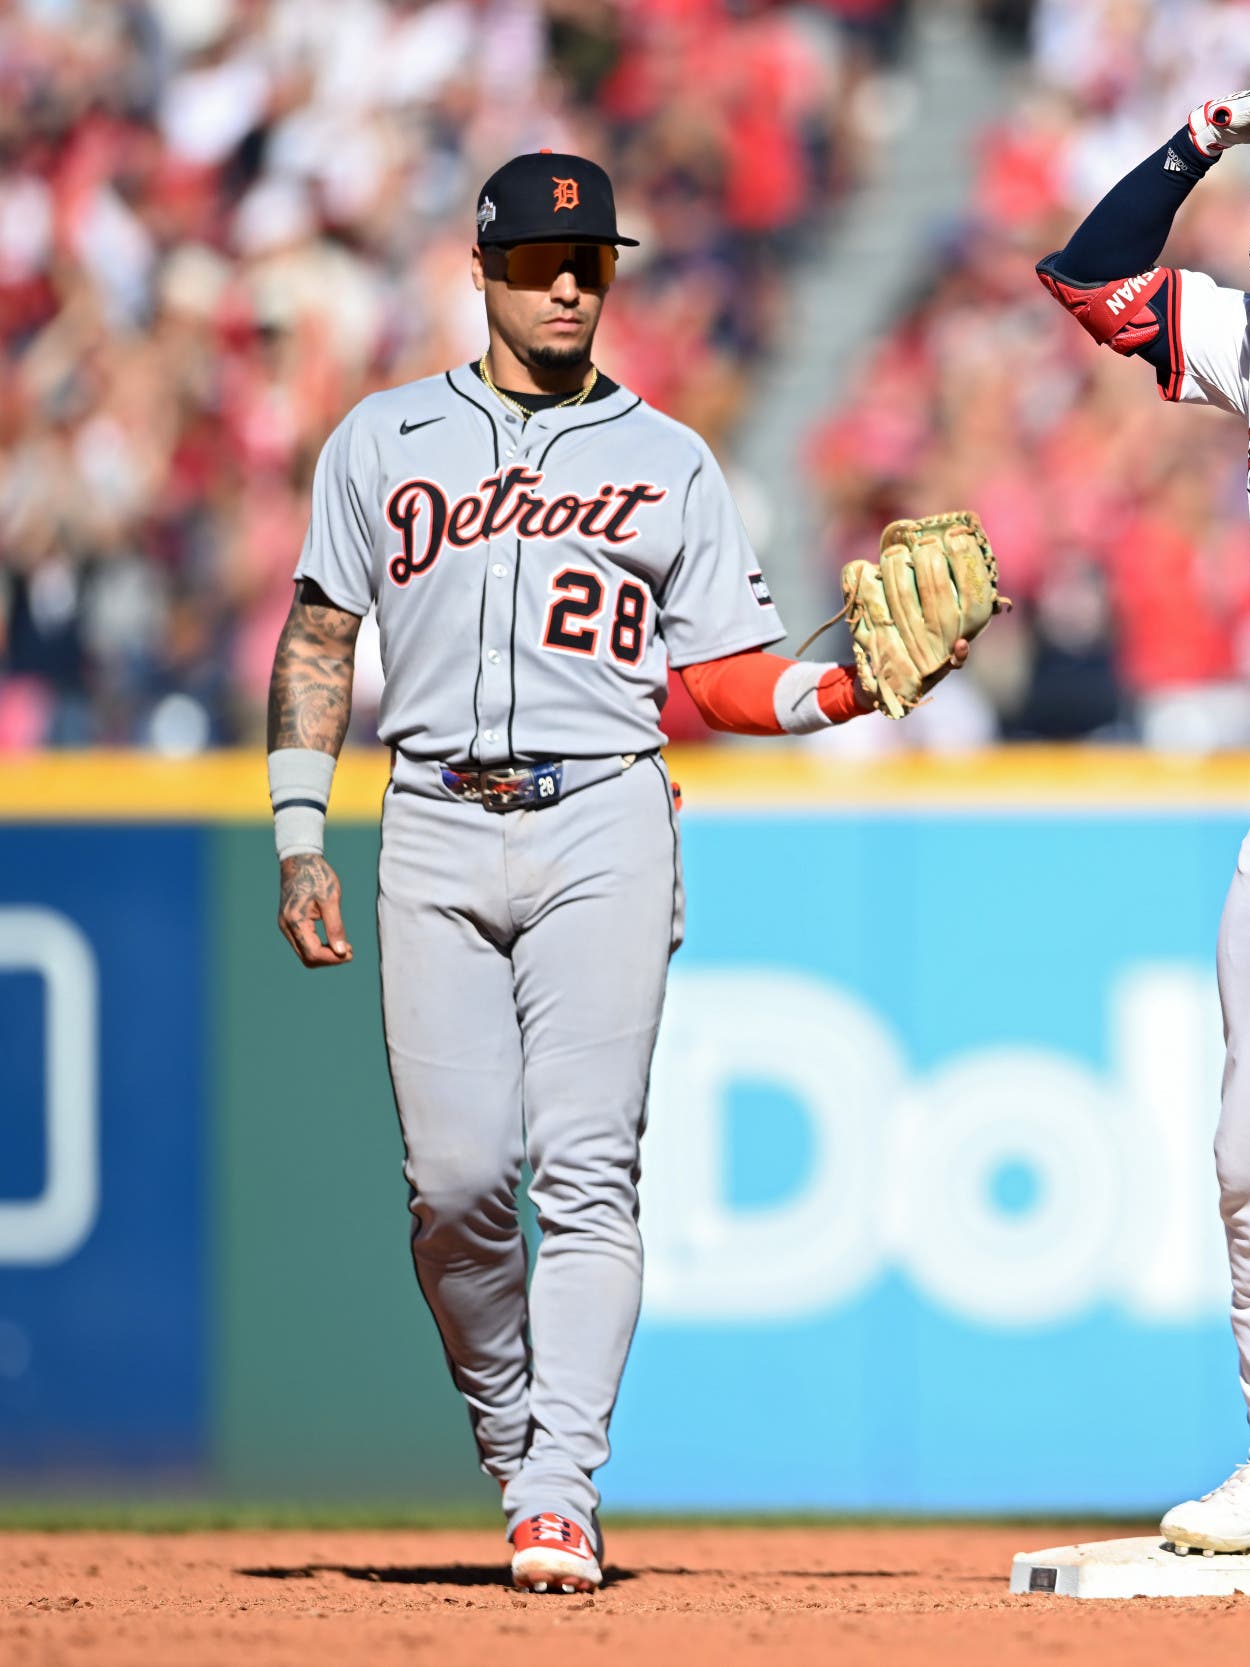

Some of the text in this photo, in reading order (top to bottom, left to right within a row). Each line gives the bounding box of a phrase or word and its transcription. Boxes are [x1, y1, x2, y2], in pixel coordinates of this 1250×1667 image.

[551, 176, 580, 213] D
[386, 465, 668, 587] Detroit
[541, 564, 651, 669] 28
